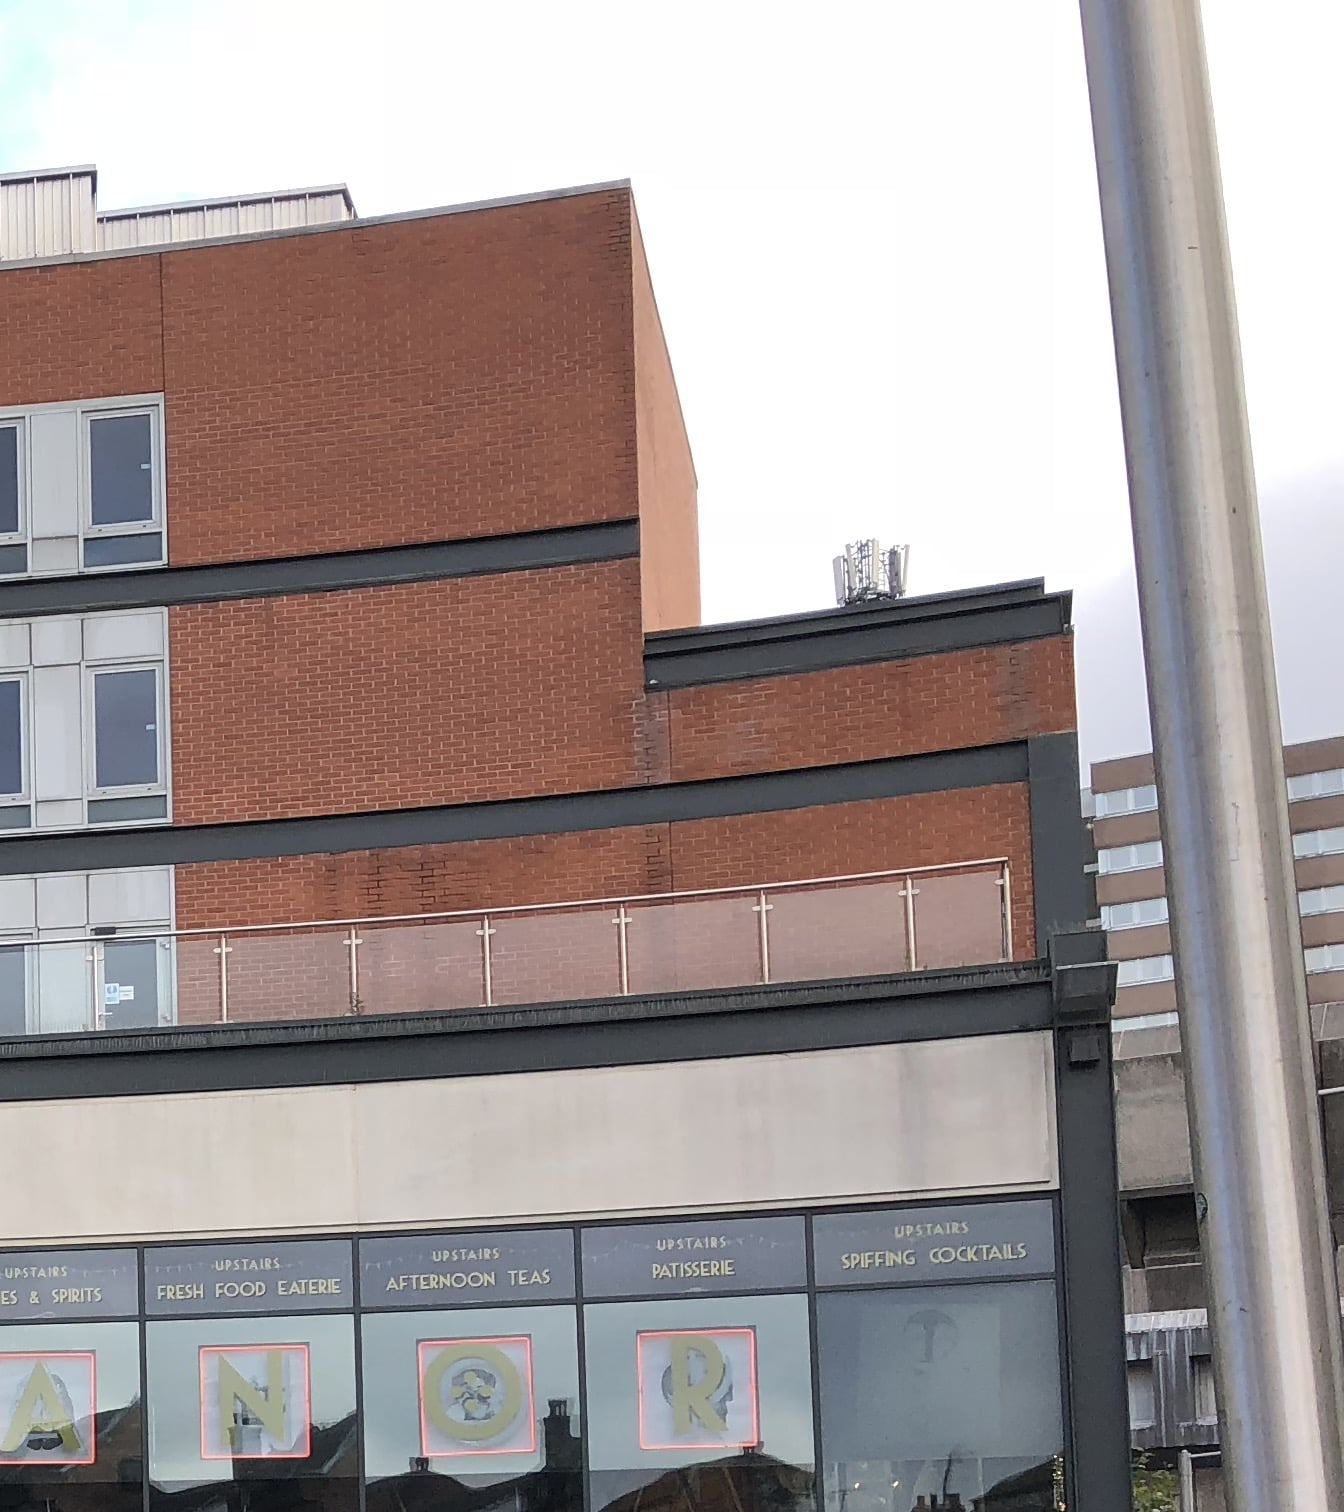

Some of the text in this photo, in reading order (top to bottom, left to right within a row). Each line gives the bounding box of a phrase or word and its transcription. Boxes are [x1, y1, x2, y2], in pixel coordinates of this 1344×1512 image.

[895, 1222, 969, 1237] UPSTAIRS
[656, 1236, 726, 1250] UPSTAIRS
[433, 1248, 500, 1262] UPSTAIRS
[841, 1243, 1028, 1270] SPIFFING COCKTAILS
[5, 1266, 68, 1279] UPSTAIRS
[215, 1258, 281, 1271] UPSTAIRS
[652, 1260, 736, 1279] PATISSERIE
[386, 1269, 551, 1292] AFTERNOON TEAS
[29, 1290, 40, 1304] &
[51, 1287, 103, 1303] SPIRITS
[157, 1278, 343, 1300] FRESH FOOD EATERIE
